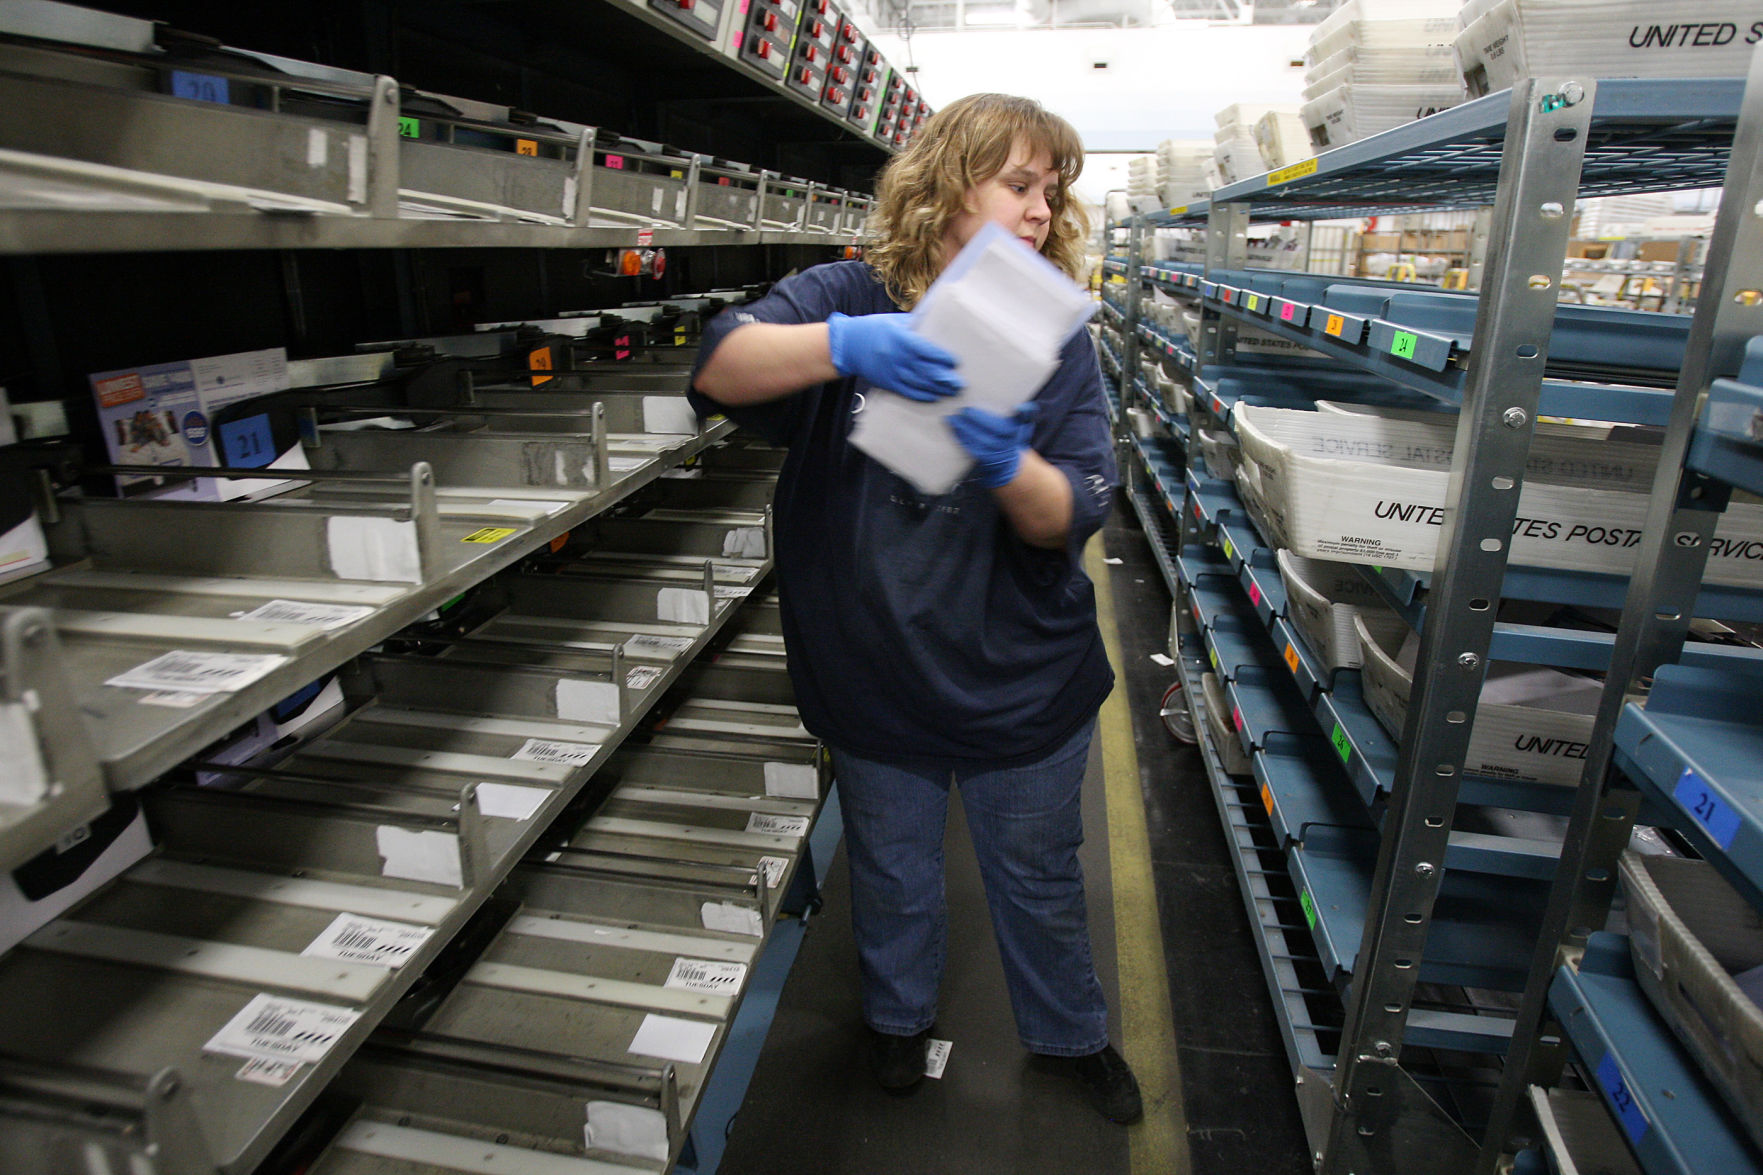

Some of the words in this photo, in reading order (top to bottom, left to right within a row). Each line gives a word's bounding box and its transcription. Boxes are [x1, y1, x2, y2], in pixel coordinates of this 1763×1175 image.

[1629, 22, 1737, 48] UNITED
[236, 431, 262, 459] 21
[1375, 500, 1445, 526] UNITE
[1512, 518, 1561, 539] TES
[1566, 525, 1643, 547] POSTA
[1341, 536, 1381, 546] WARNING
[1694, 792, 1715, 822] 21
[337, 950, 382, 962] TUESDAY
[685, 981, 720, 990] TUESDAY
[249, 1037, 301, 1052] TUESDAY
[1612, 1081, 1631, 1113] 22
